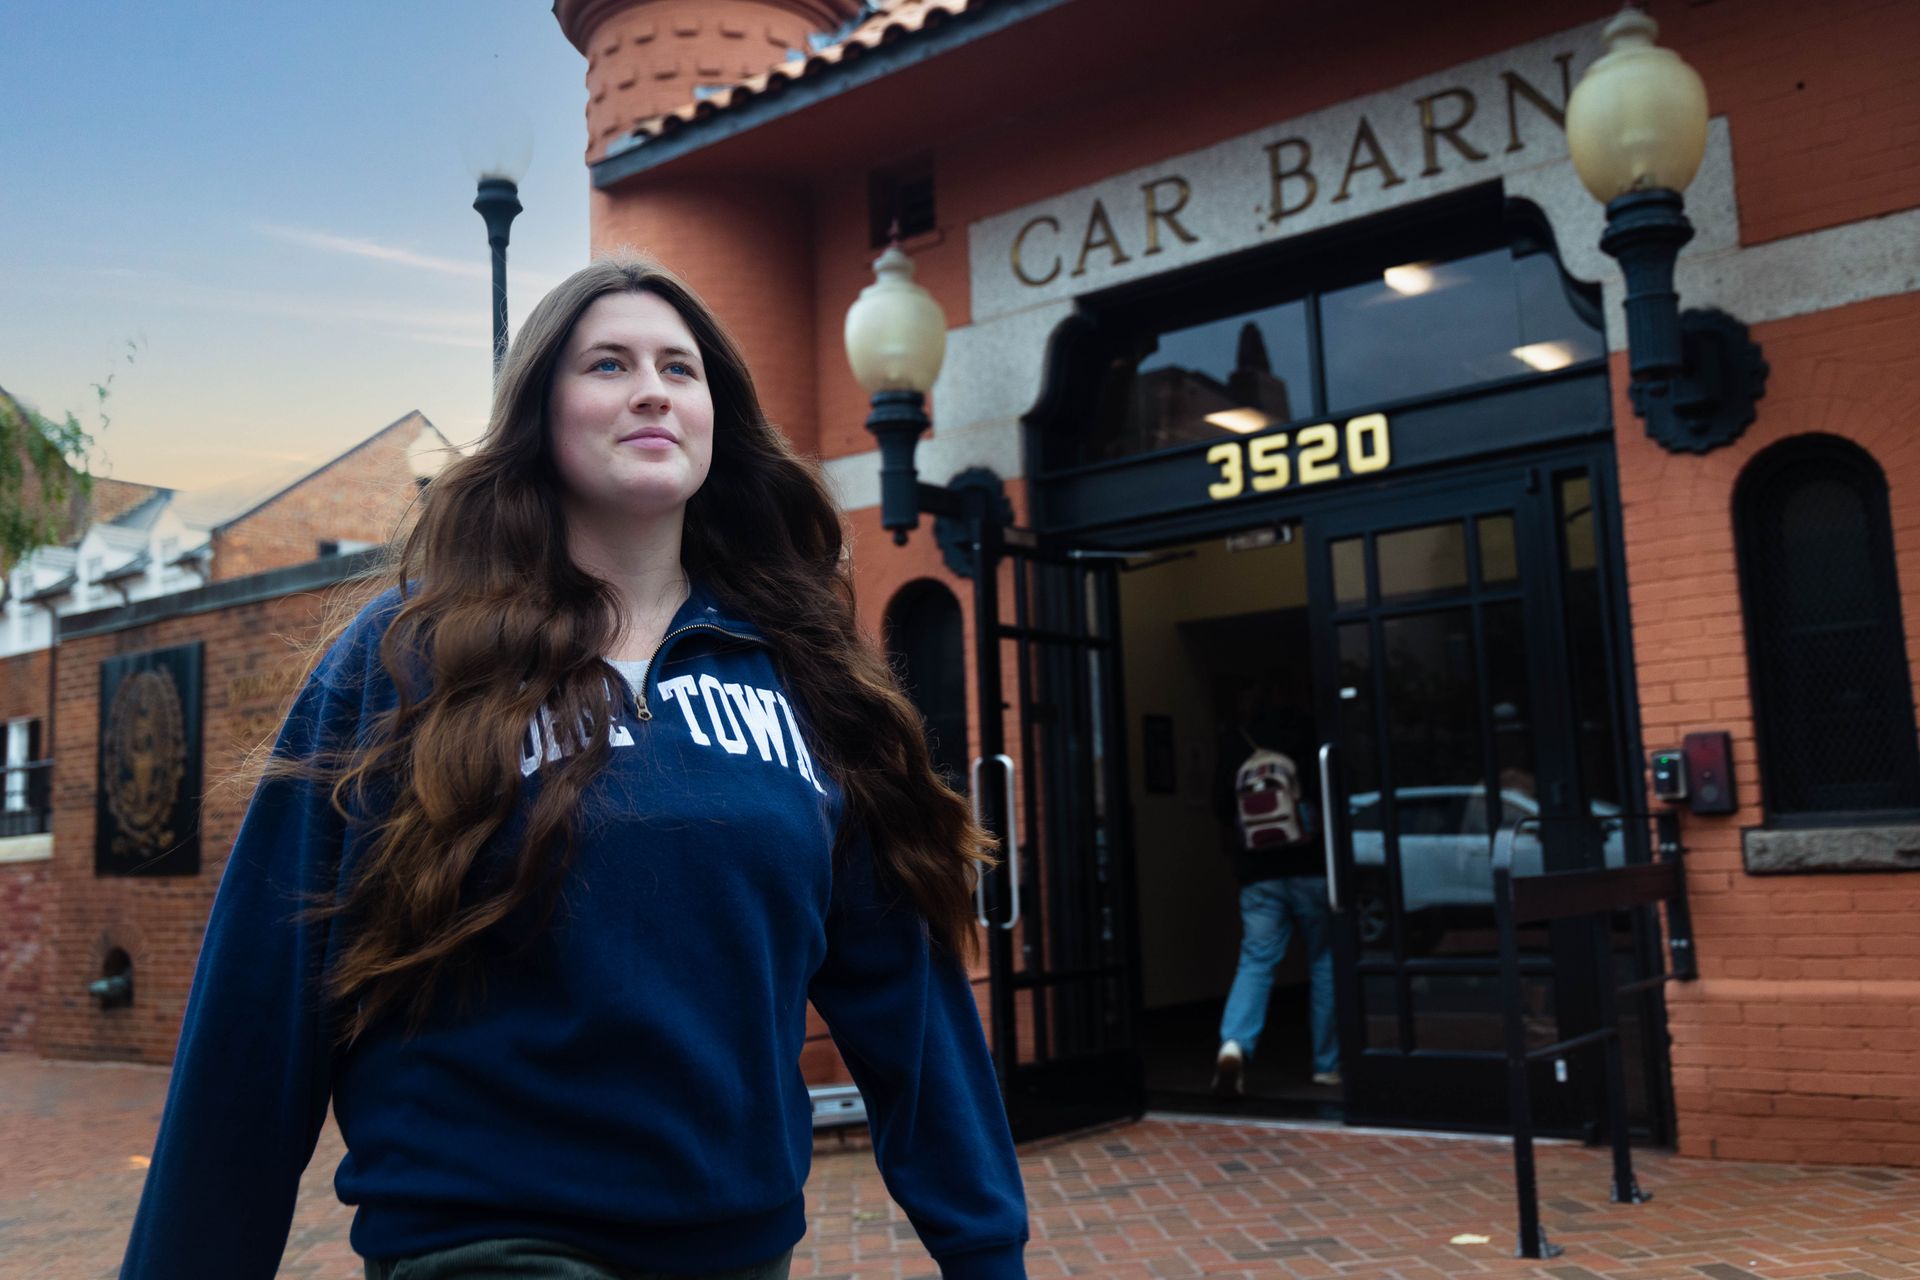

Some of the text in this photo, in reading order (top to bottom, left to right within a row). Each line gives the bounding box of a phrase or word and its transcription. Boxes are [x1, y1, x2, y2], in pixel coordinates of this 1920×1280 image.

[1010, 51, 1574, 288] CAR BARN
[1206, 412, 1390, 500] 3520
